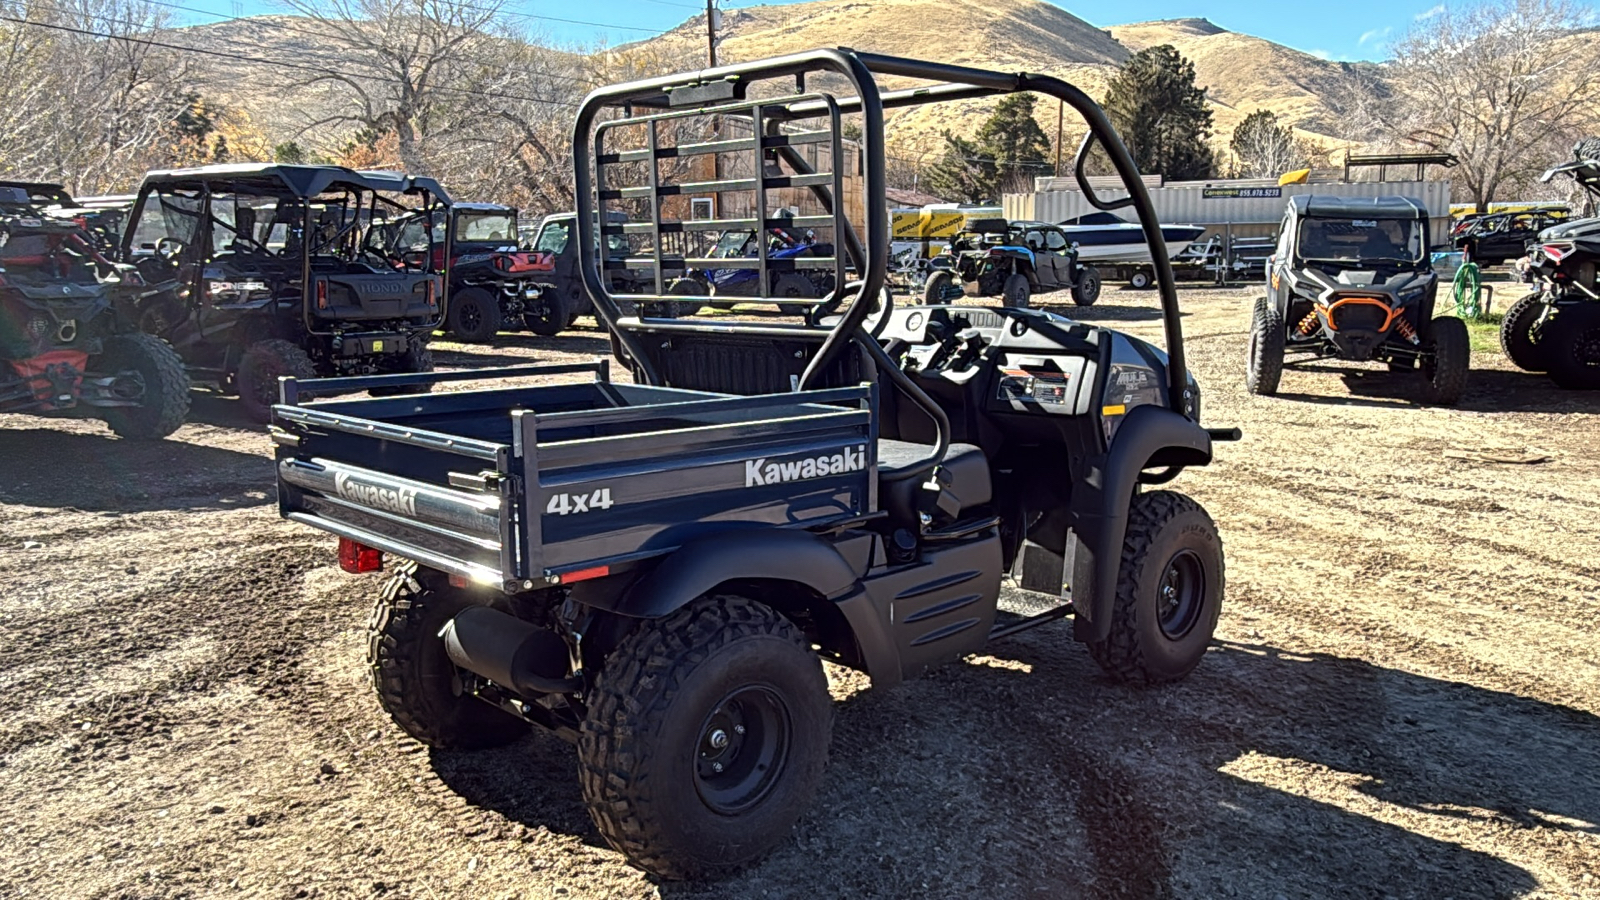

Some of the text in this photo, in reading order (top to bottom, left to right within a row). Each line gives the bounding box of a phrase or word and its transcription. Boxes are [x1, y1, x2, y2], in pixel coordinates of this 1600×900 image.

[210, 281, 268, 290] PIONEER
[360, 283, 409, 294] HONDA
[745, 444, 865, 488] Kawasaki
[334, 471, 417, 516] Kawasaki
[546, 488, 615, 515] 4x4
